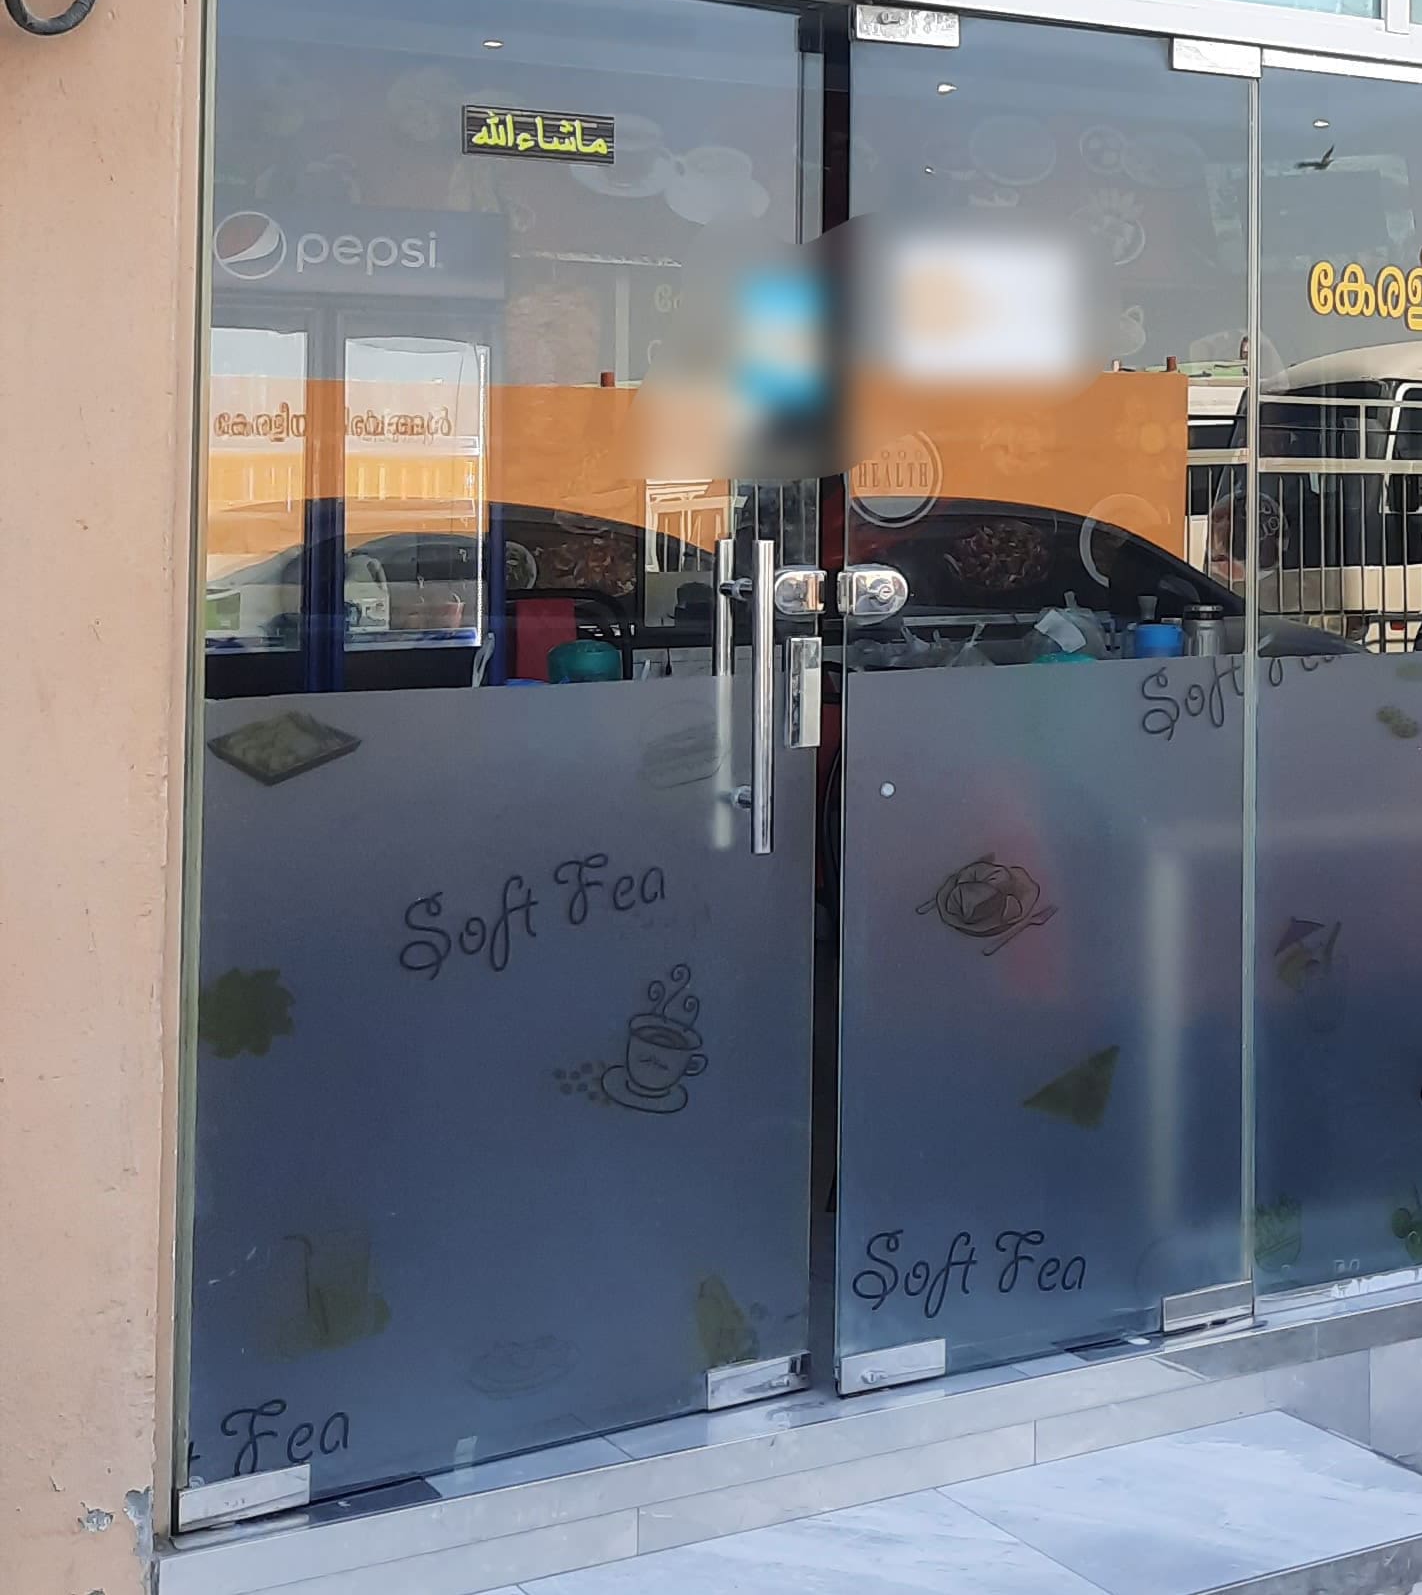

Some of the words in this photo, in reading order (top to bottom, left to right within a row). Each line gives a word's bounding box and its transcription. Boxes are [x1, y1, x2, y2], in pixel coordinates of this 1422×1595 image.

[296, 231, 438, 276] pepsi
[400, 874, 539, 981] Soft
[852, 1229, 978, 1318] Soft
